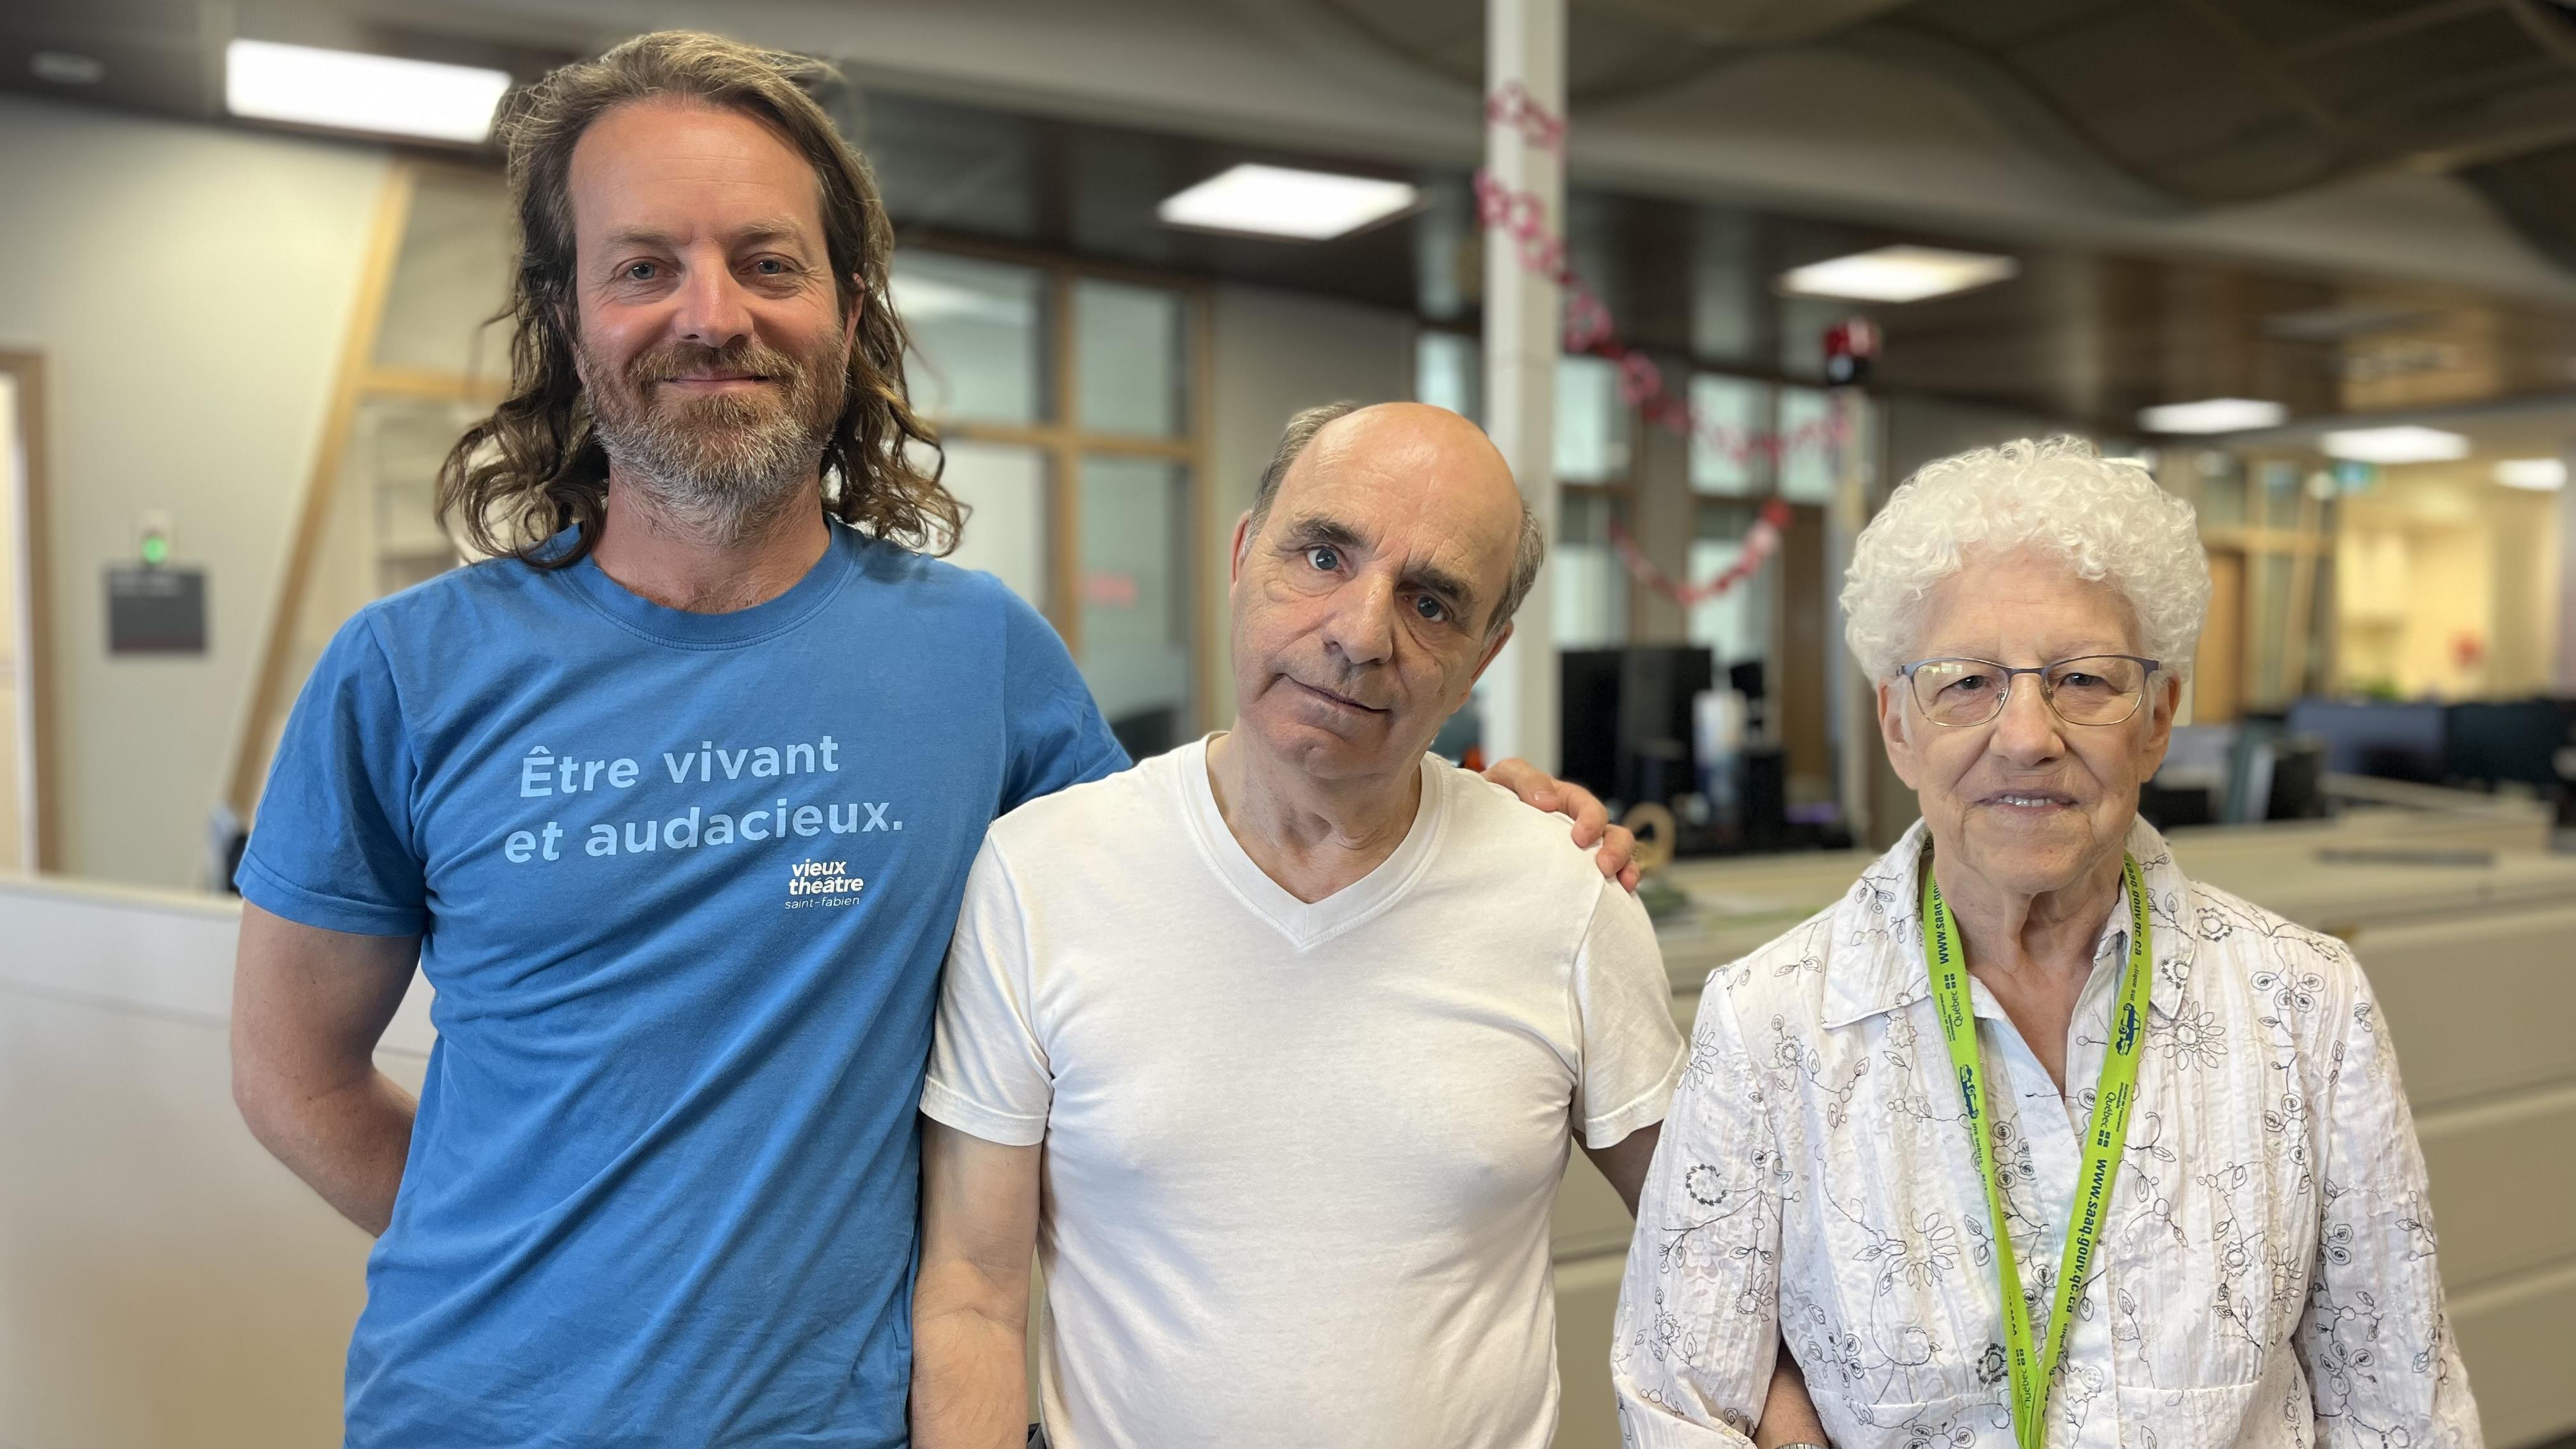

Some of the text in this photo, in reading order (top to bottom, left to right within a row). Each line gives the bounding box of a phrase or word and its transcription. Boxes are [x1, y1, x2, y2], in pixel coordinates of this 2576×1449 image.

[519, 735, 839, 798] Être vivant
[504, 798, 903, 863] et audacieux.
[788, 875, 864, 896] théâtre
[792, 859, 847, 878] vieux
[785, 896, 860, 910] saint-fabien
[1951, 990, 1963, 1027] Québec
[2101, 1092, 2117, 1129] Québec
[2066, 1159, 2108, 1314] www.saaq.gouv.qc.ca
